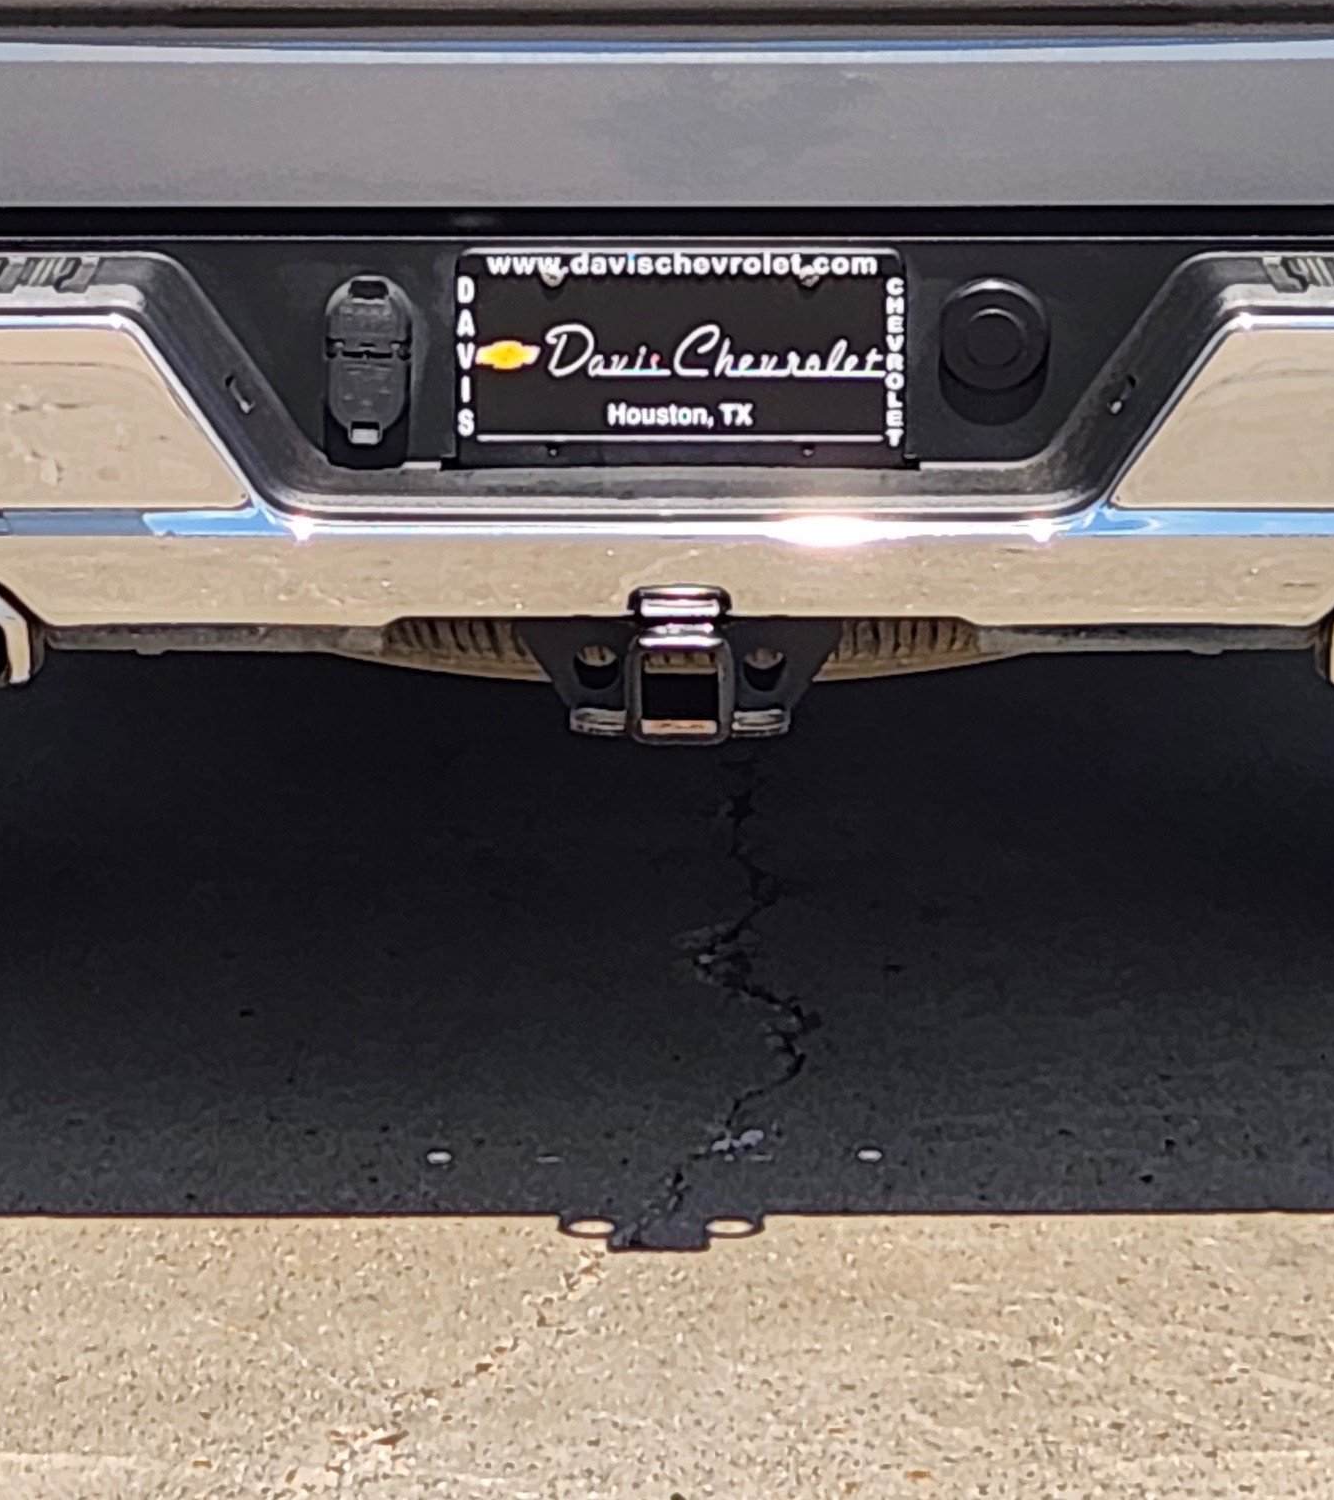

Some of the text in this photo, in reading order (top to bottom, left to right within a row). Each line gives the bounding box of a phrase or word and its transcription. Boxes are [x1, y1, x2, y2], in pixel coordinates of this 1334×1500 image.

[485, 252, 879, 277] www.davischevroletcom
[455, 275, 476, 438] DAVIS
[544, 322, 887, 378] Davis Chevrolet
[884, 276, 906, 448] CHEVROLET
[607, 402, 754, 429] Houston, TX
